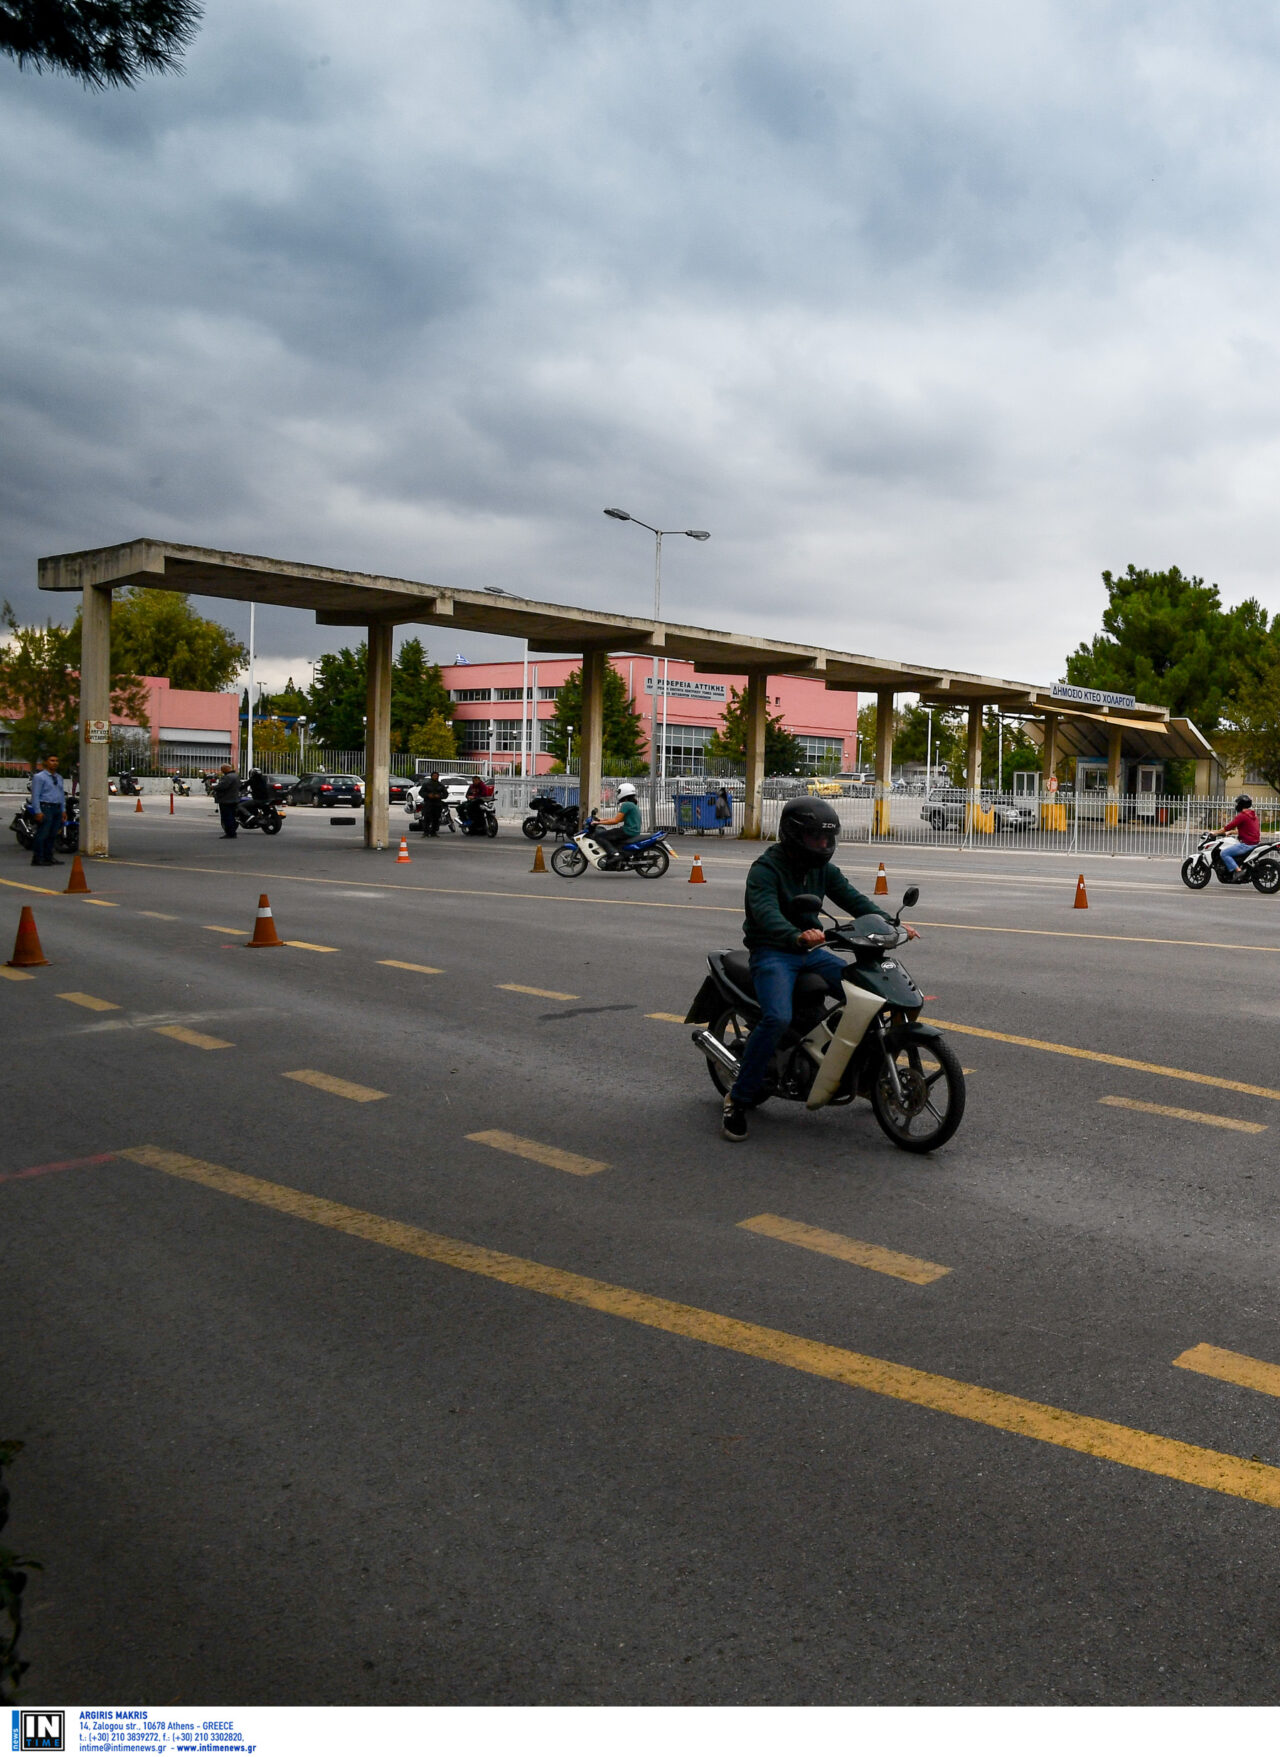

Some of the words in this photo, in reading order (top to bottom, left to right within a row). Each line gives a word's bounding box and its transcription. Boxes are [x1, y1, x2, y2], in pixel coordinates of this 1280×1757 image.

[647, 678, 691, 688] ΠΡΙΦΕΡΕΙΑ
[695, 683, 724, 692] ΑΤΤΙΚΗΣ
[1052, 686, 1083, 699] ΔΗΜΟΣΙΟ
[1084, 692, 1101, 702] ΚΤΕΟ
[1103, 695, 1134, 707] ΧΟΛΑΡΓΟΥ
